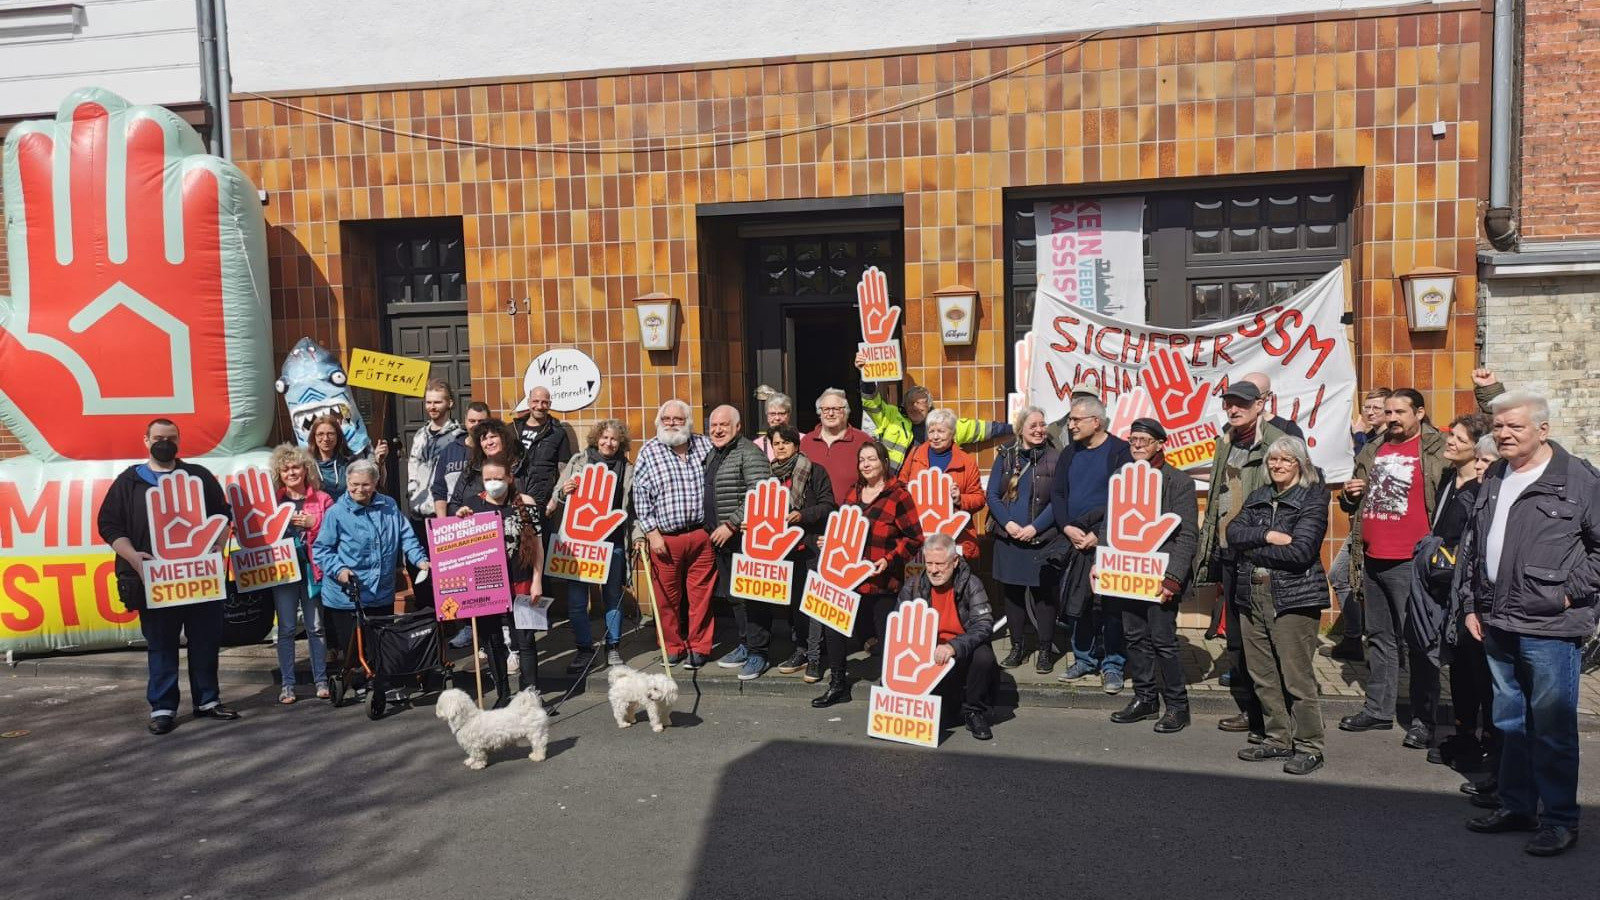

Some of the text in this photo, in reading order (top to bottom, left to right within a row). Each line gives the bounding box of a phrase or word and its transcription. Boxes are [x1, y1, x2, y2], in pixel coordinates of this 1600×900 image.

[1079, 259, 1094, 310] VEEDE
[361, 355, 405, 369] NICHT
[861, 345, 897, 361] MIETEN
[537, 357, 579, 375] Wohnen
[863, 361, 898, 377] STOPP!
[355, 368, 424, 391] FÜTTERN!
[551, 375, 561, 386] ist
[1165, 441, 1216, 467] STOPP
[432, 518, 475, 536] WOHNEN
[434, 521, 498, 545] UND ENERGIE
[236, 545, 291, 569] MIETEN
[553, 540, 607, 561] MIETEN
[150, 559, 217, 582] MIETEN
[239, 562, 296, 588] STOPP!
[550, 557, 605, 579] STOPP!
[736, 560, 788, 581] MIETEN
[1102, 553, 1163, 576] MIETEN
[152, 578, 220, 602] STOPP!
[735, 577, 787, 600] STOPP!
[809, 578, 855, 612] MIETEN
[805, 594, 851, 630] STOPP!
[875, 692, 934, 719] MIETEN
[873, 714, 933, 741] STOPP!
